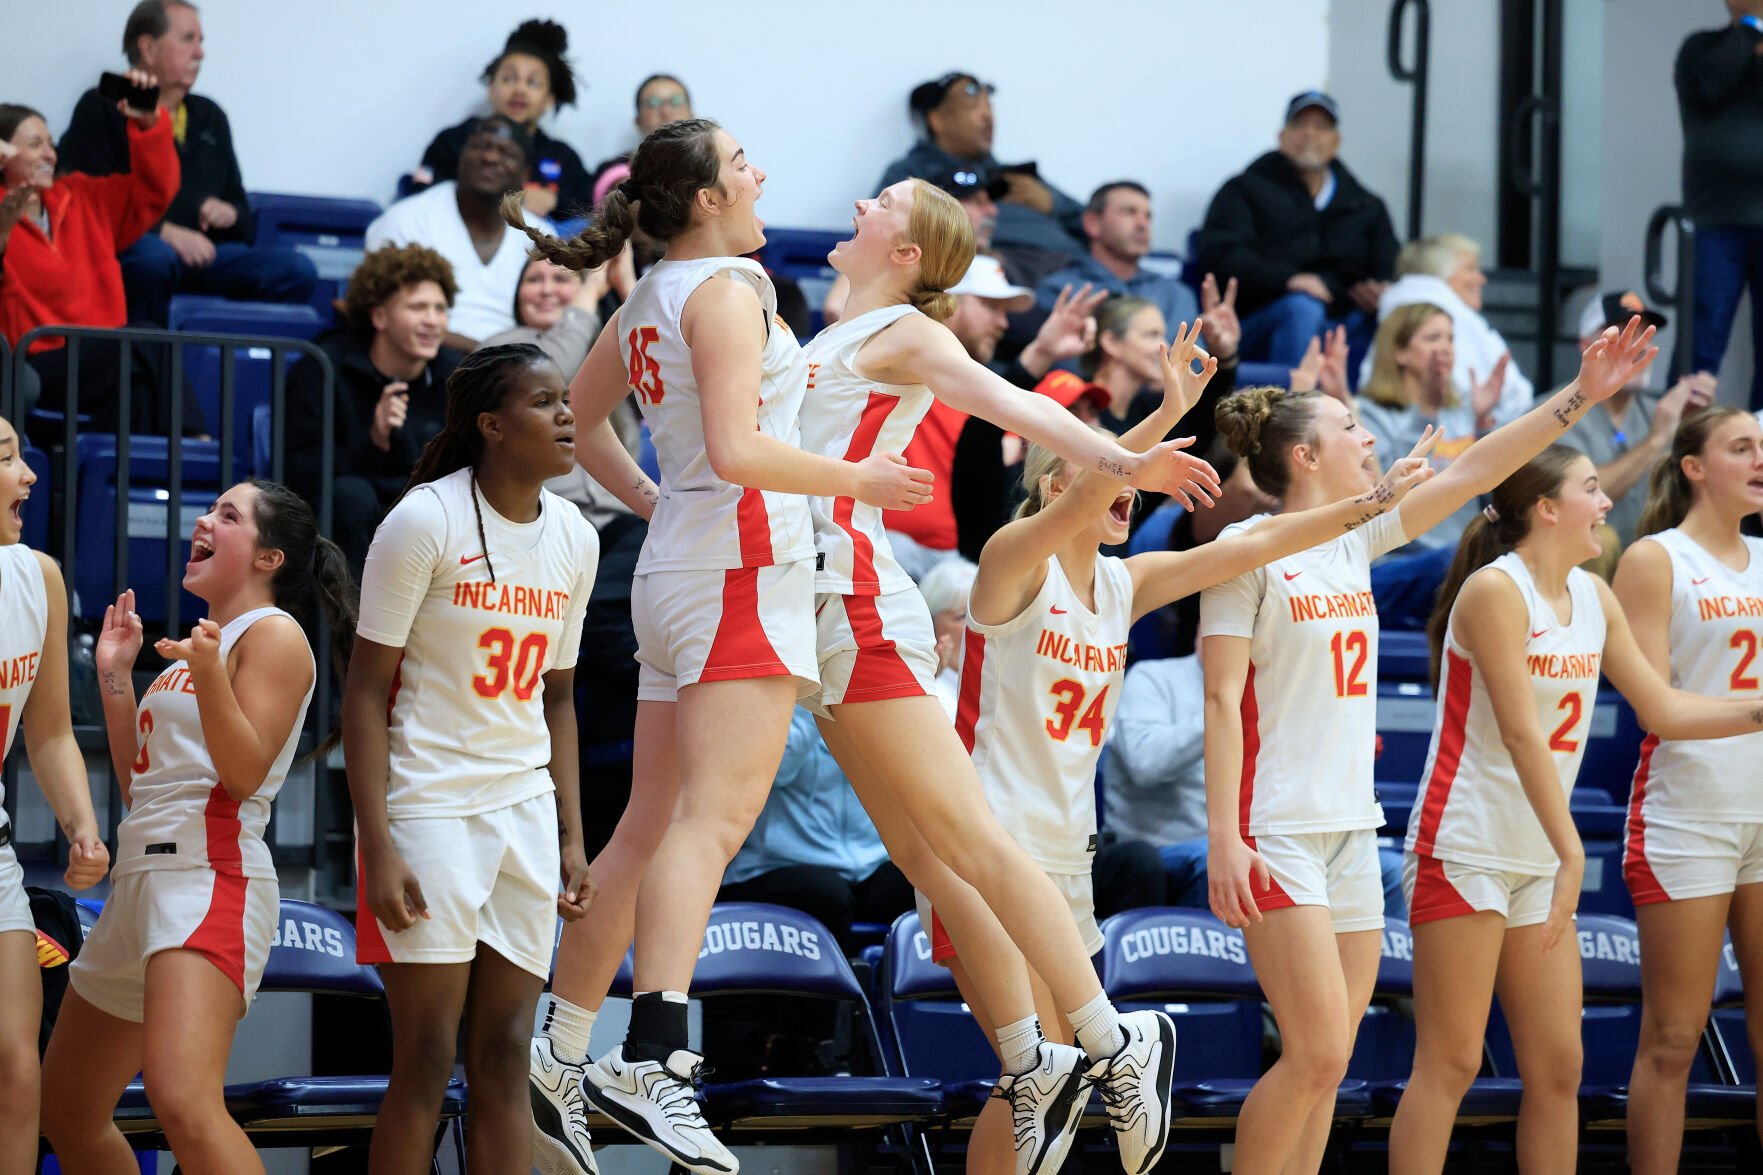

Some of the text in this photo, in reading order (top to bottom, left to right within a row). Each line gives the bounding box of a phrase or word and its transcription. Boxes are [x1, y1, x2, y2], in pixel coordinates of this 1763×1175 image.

[629, 325, 665, 405] 45
[471, 625, 549, 702] 30
[1329, 628, 1369, 699] 12
[1728, 627, 1763, 691] 2
[1044, 676, 1111, 748] 34
[1547, 690, 1583, 753] 2
[1120, 925, 1248, 965] COUGARS
